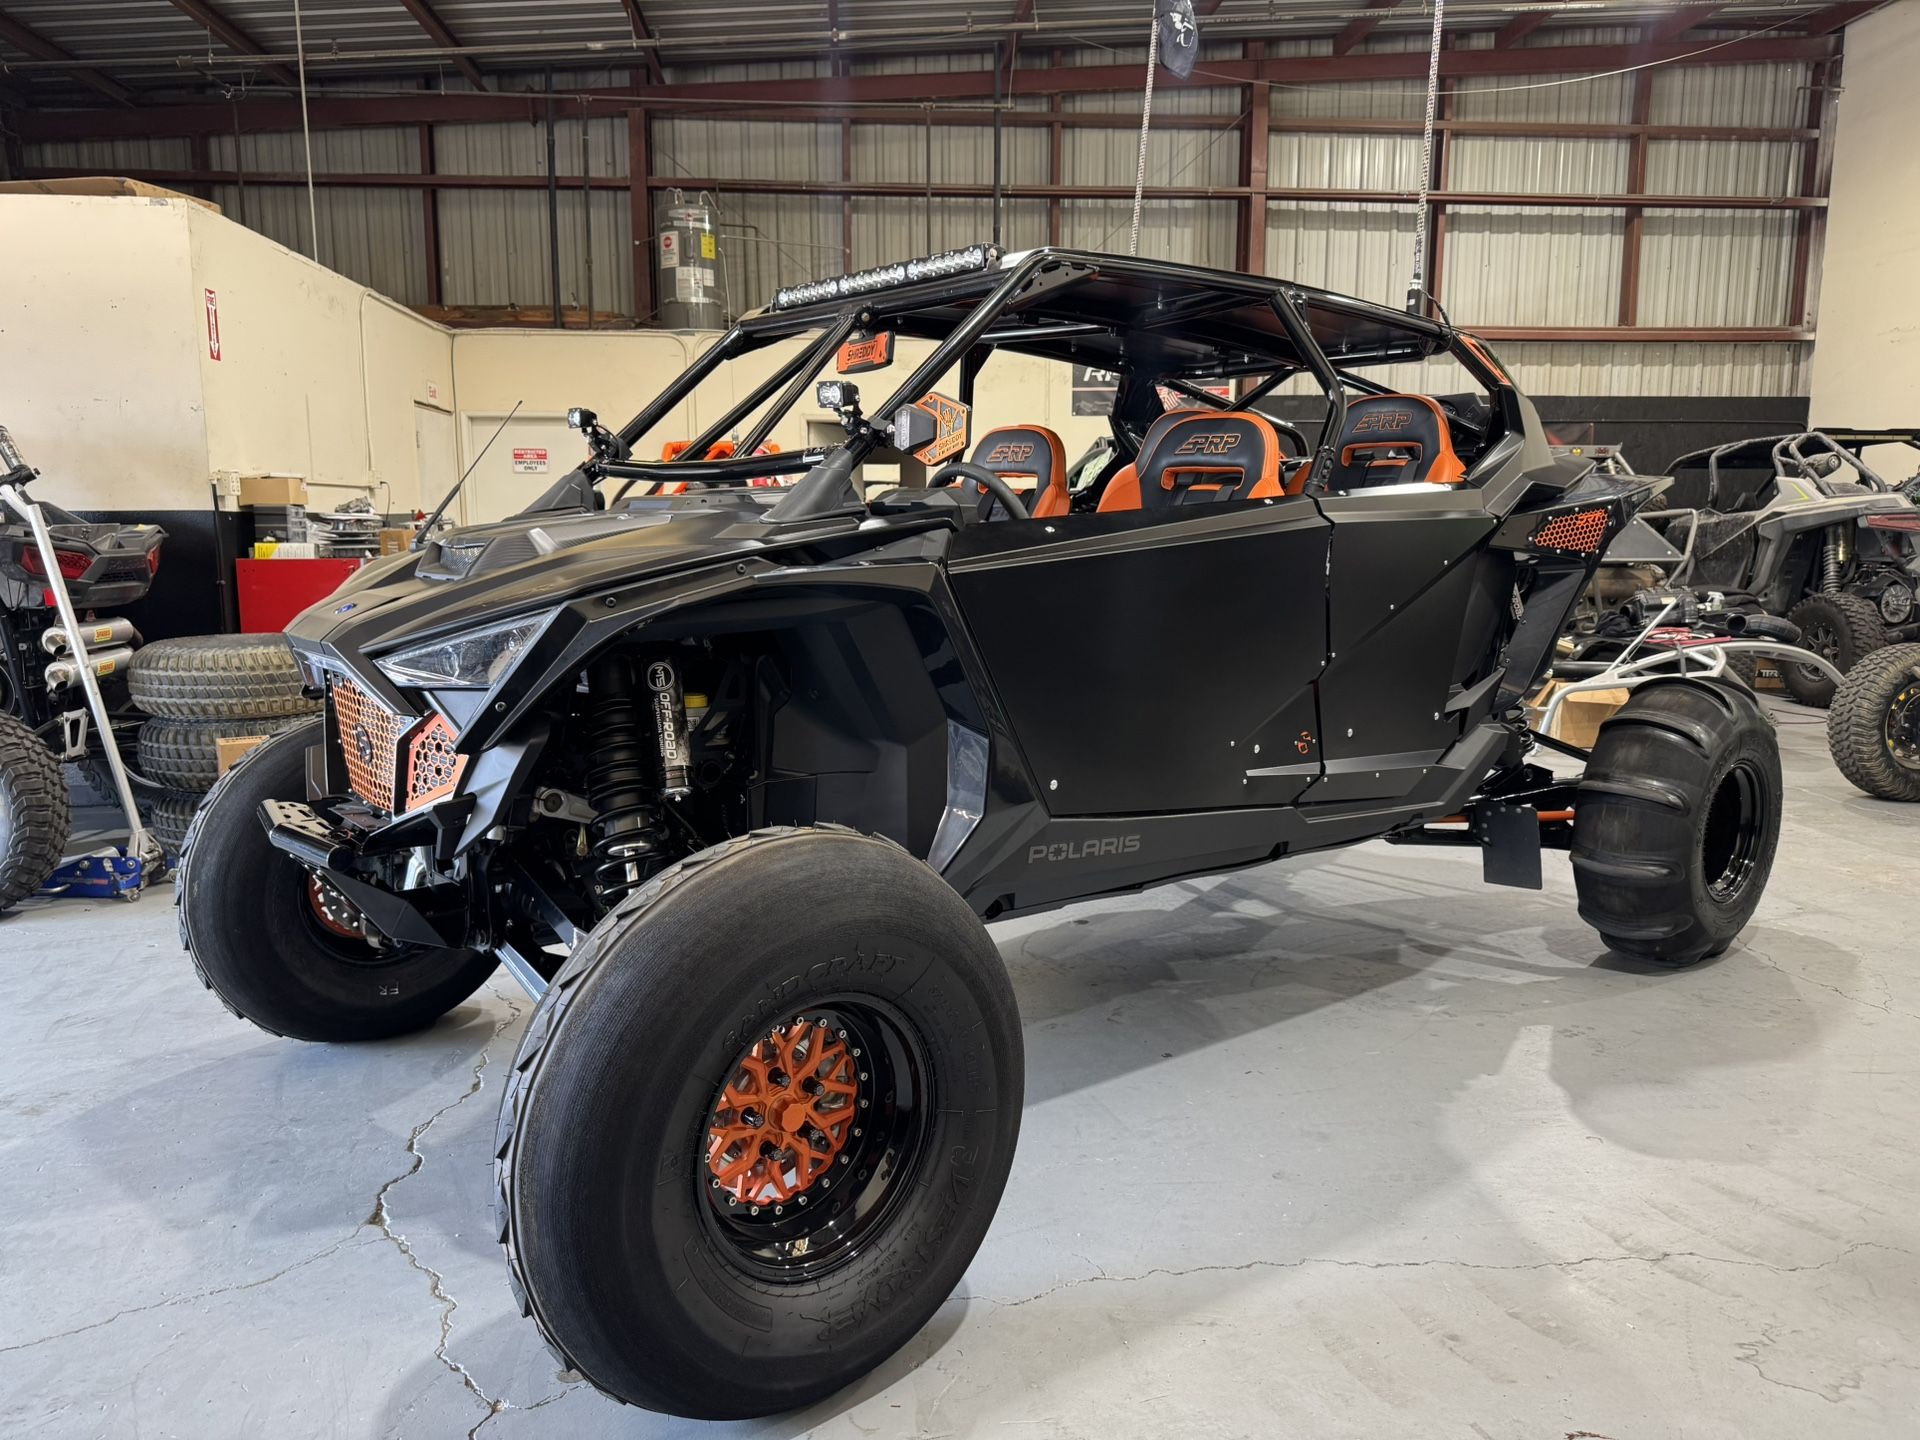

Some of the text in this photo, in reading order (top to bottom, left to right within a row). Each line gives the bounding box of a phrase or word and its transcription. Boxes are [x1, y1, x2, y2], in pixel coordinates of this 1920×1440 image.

[847, 343, 877, 361] SHREDDY
[1352, 408, 1413, 434] PRP
[985, 441, 1035, 463] PRP
[1174, 433, 1242, 455] PRP
[655, 666, 666, 687] MTS
[660, 692, 677, 759] OFF-ROAD
[1028, 835, 1140, 864] POLARIS
